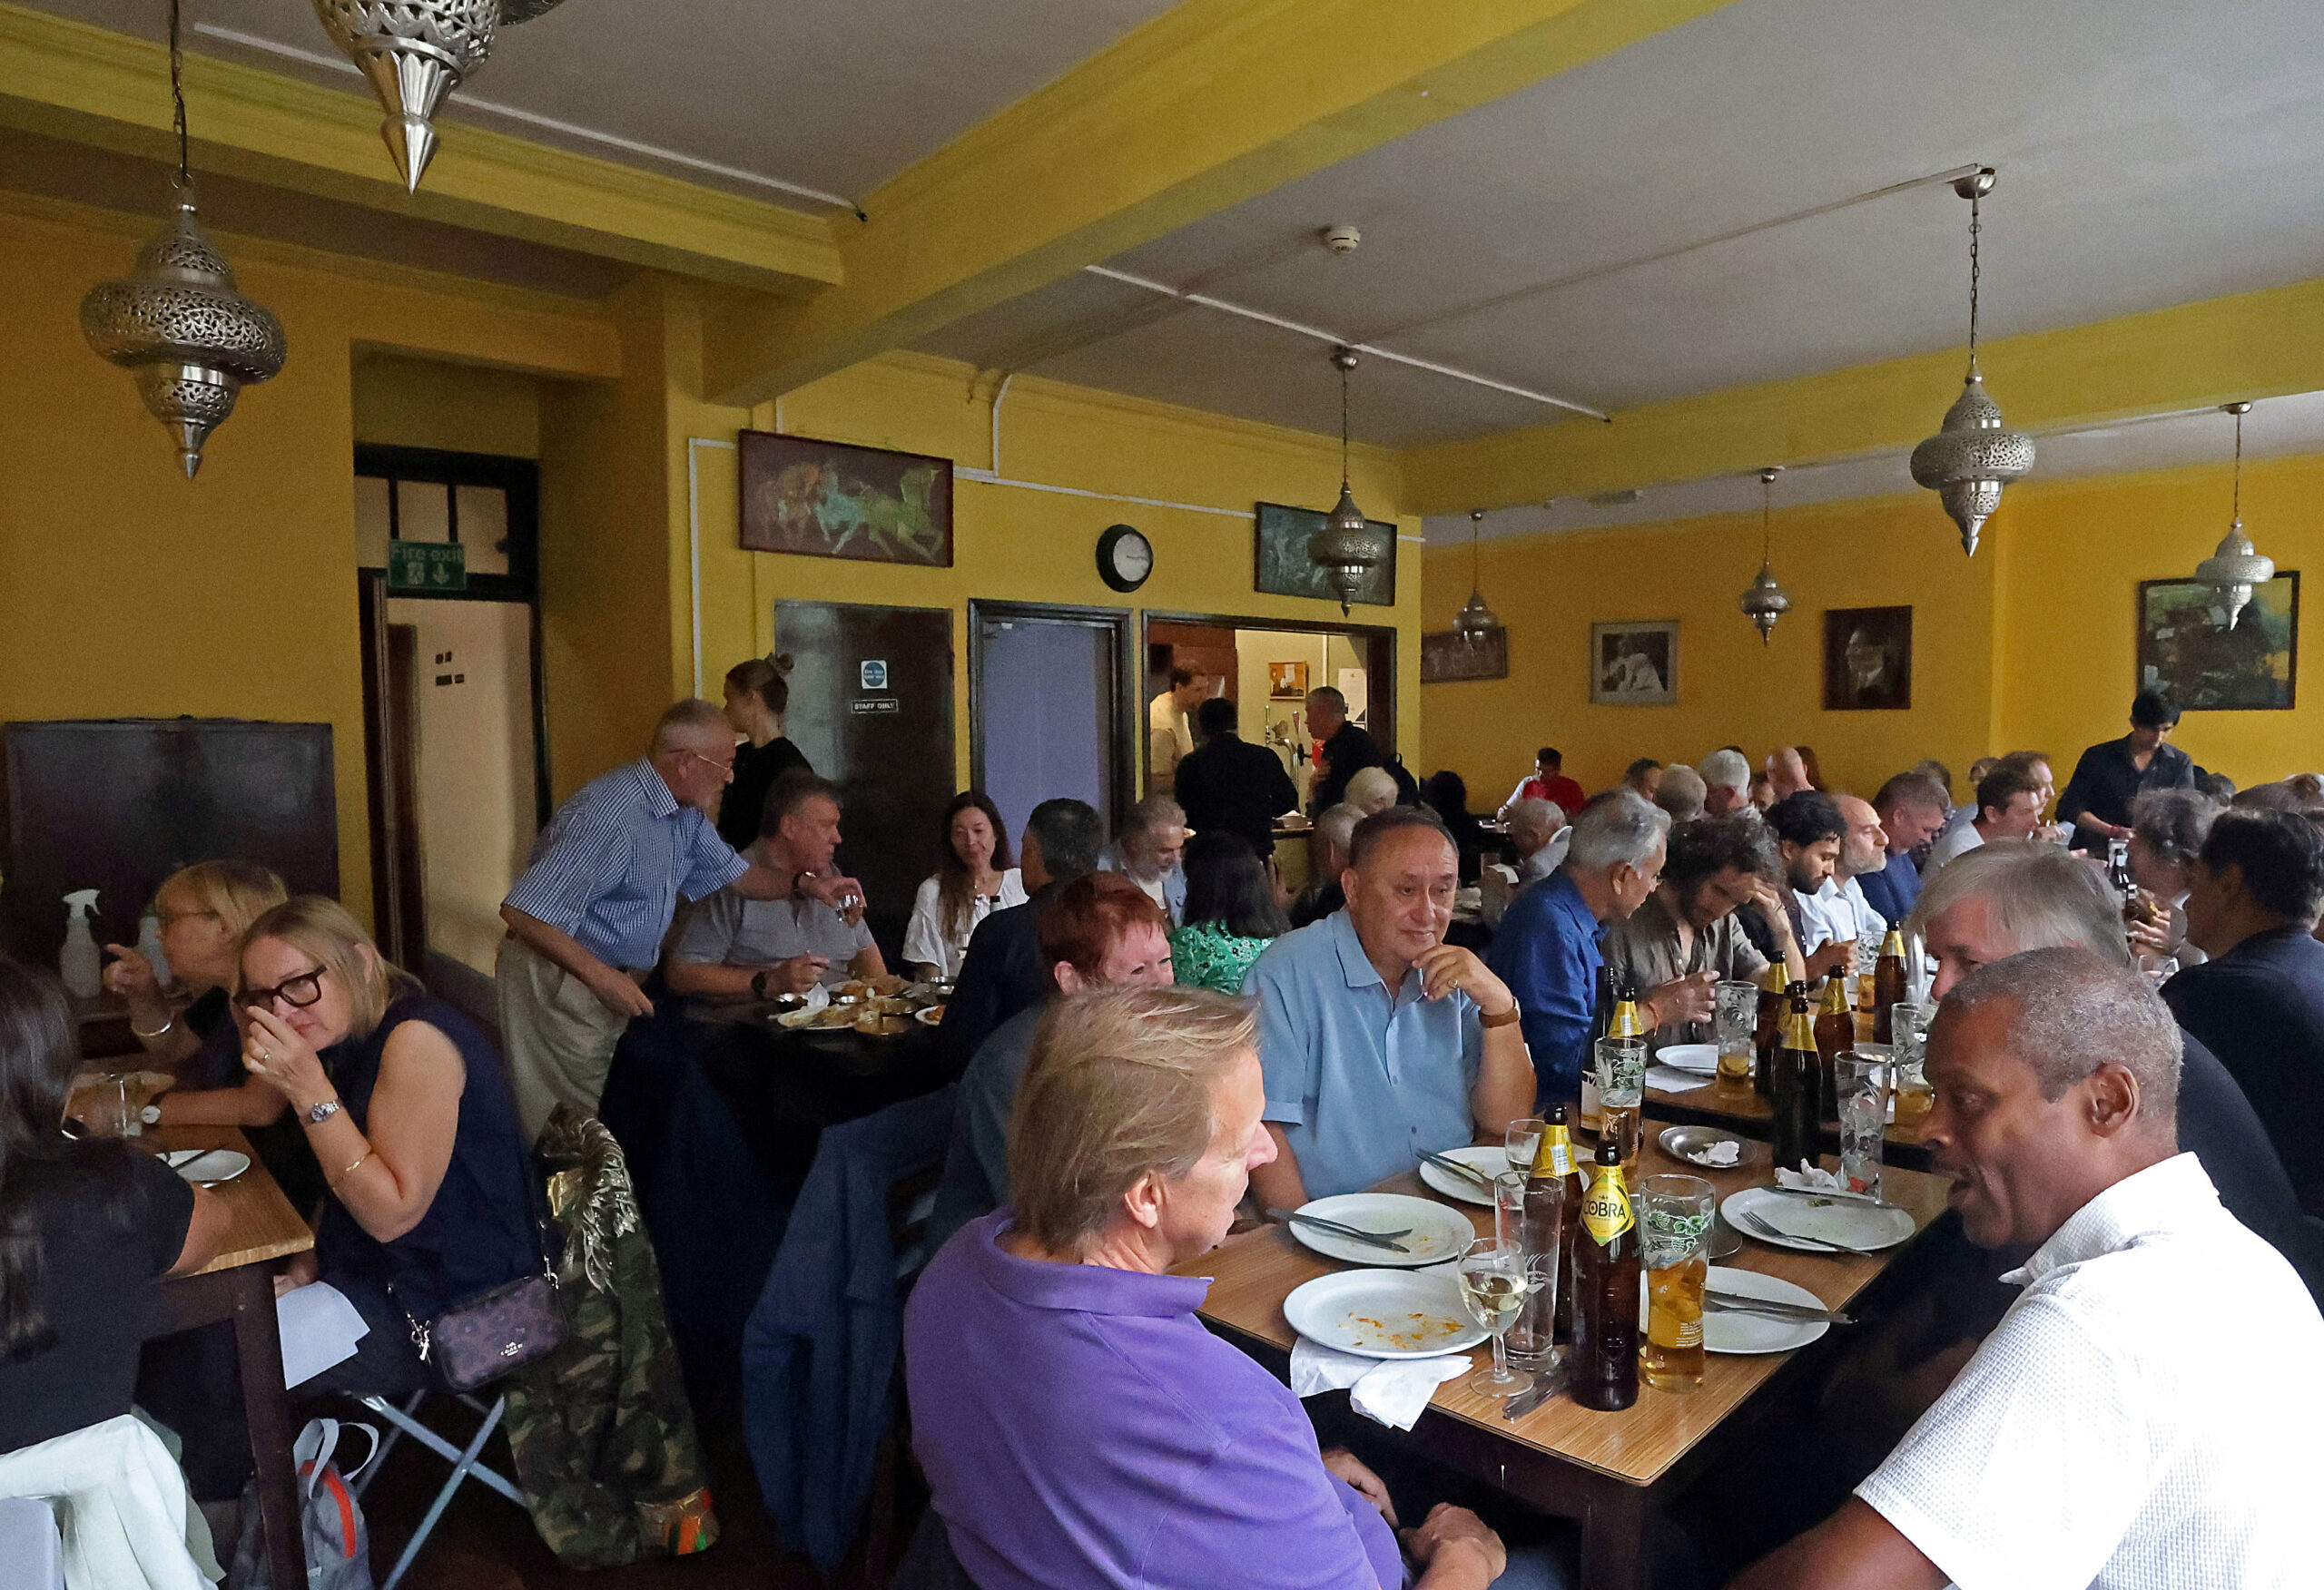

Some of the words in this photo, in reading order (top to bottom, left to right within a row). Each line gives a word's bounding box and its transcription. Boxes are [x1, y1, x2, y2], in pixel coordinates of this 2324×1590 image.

[390, 545, 426, 561] Fire
[430, 547, 464, 562] exit
[854, 702, 875, 711] STAFF
[877, 702, 895, 710] ONLY
[1583, 1200, 1627, 1219] COBRA
